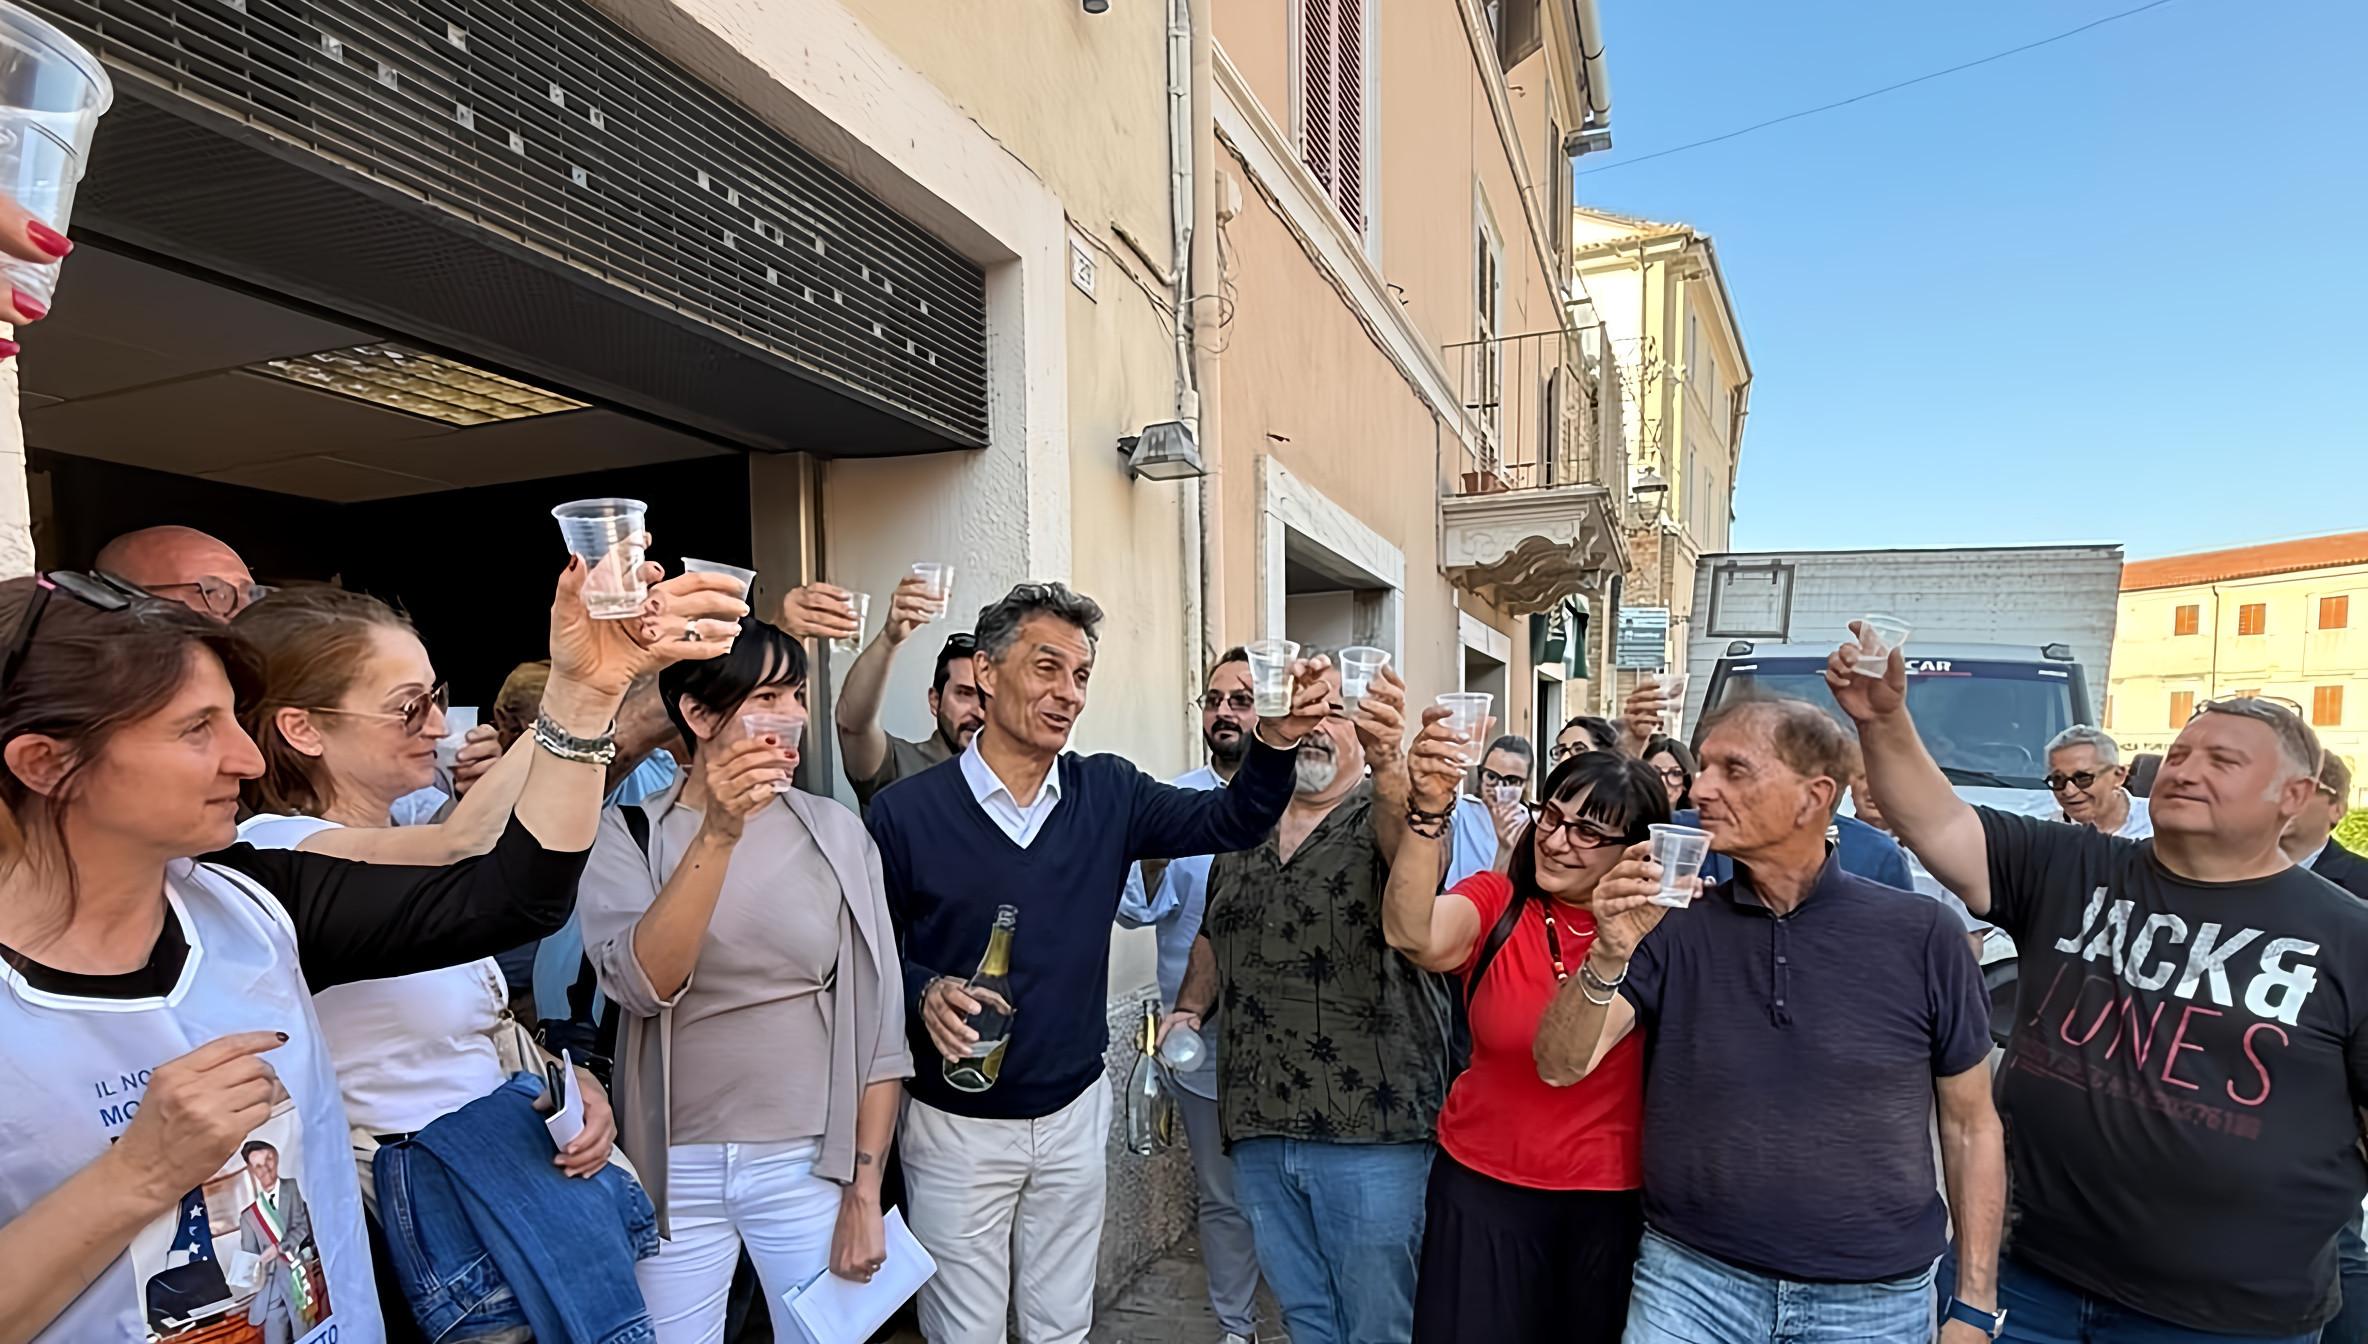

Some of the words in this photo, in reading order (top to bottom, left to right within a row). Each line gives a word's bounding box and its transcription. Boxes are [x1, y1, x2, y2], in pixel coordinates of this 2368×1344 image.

[95, 1081, 117, 1098] IL
[120, 1069, 153, 1092] NO
[100, 1100, 141, 1128] MO
